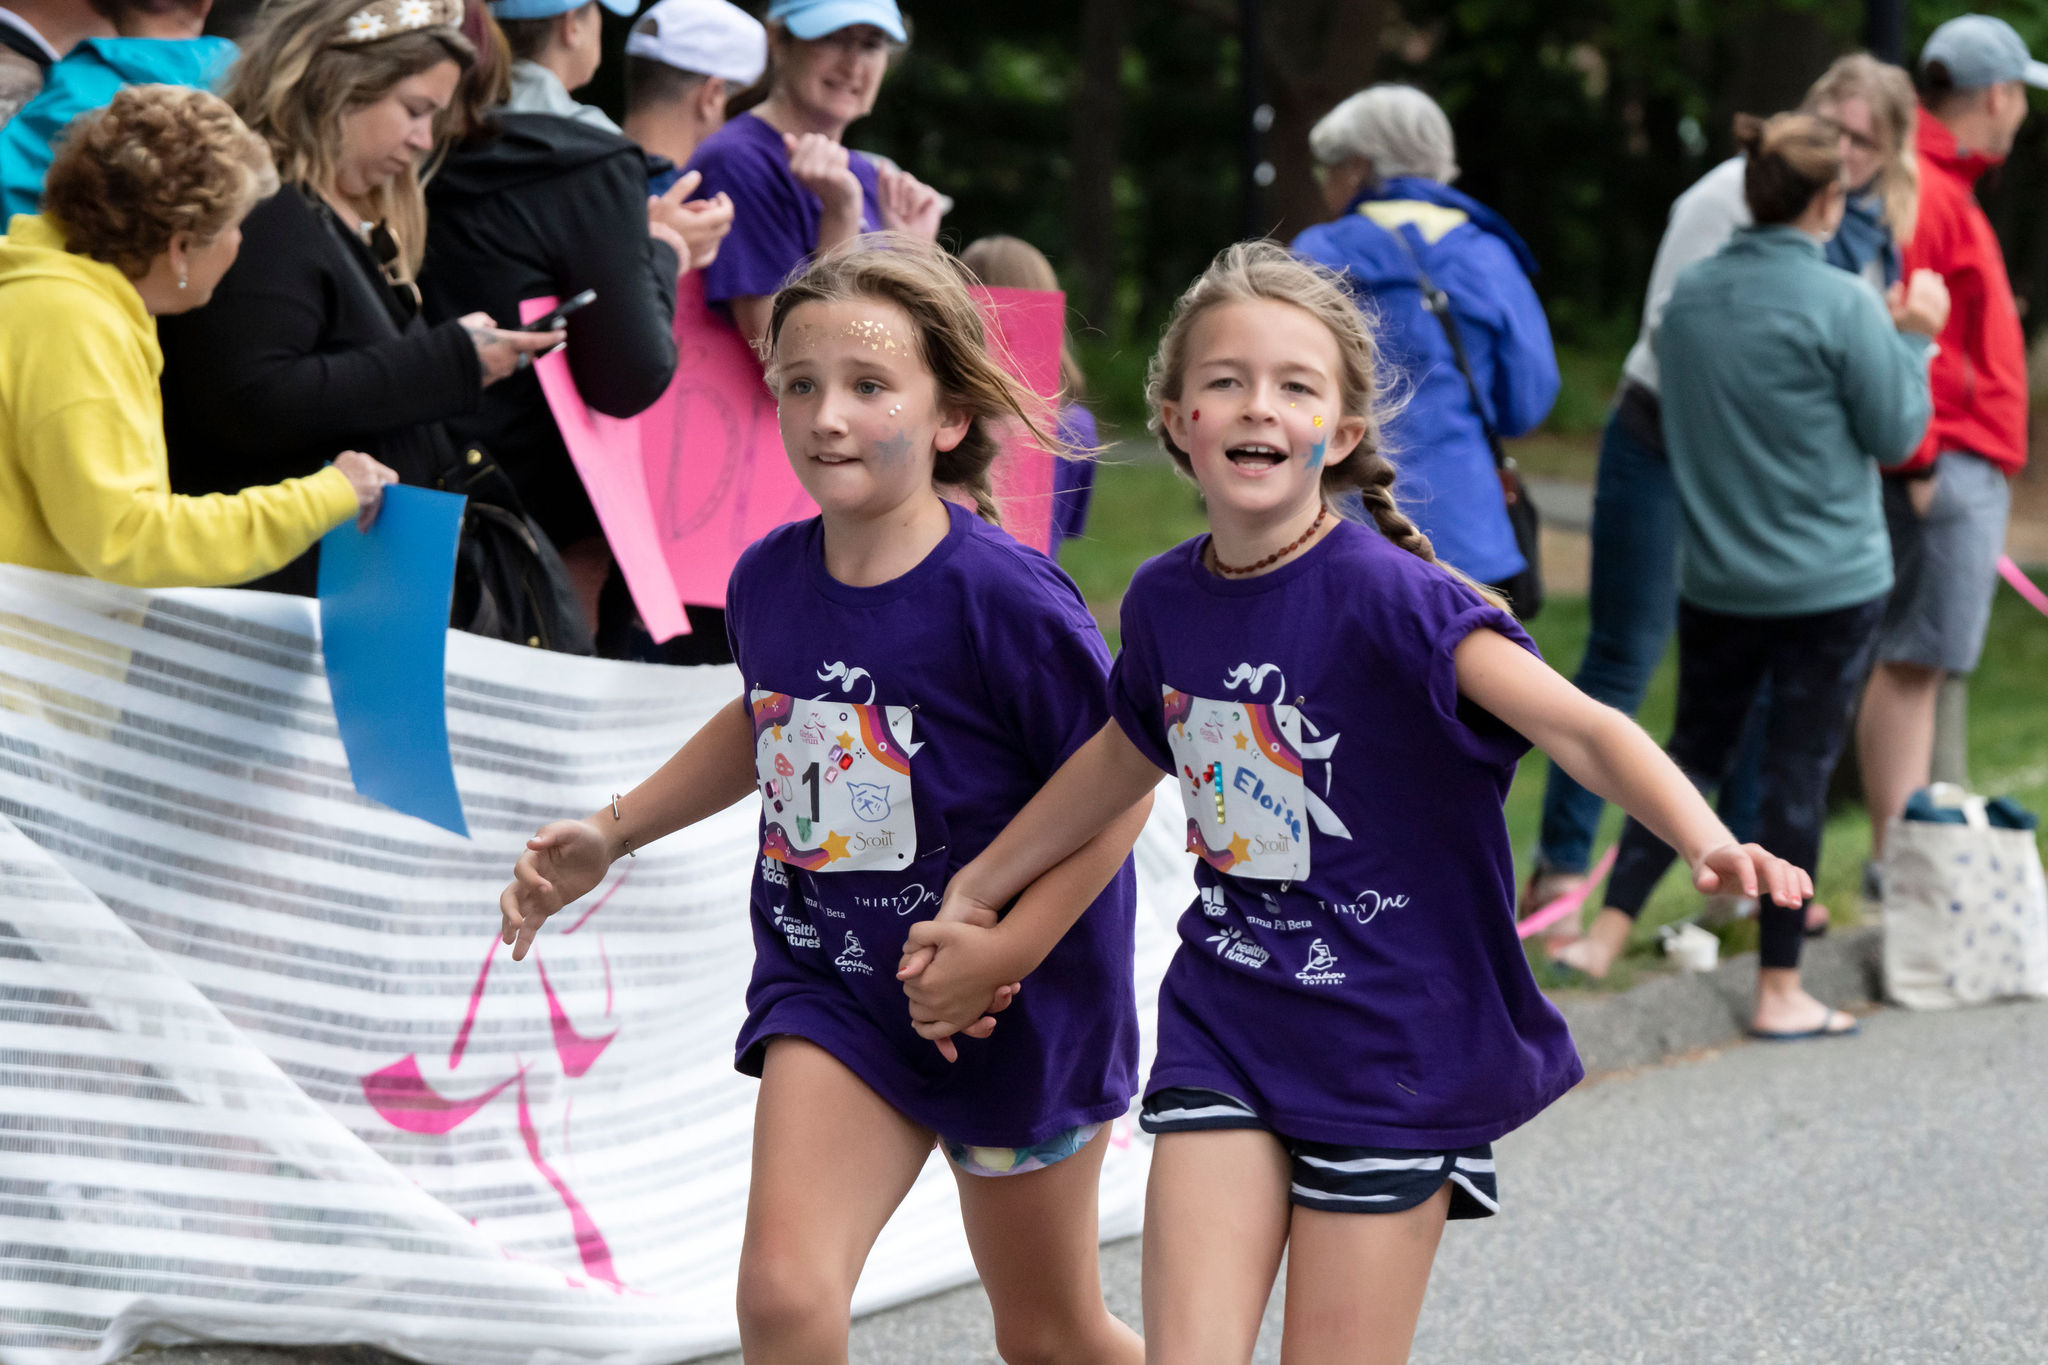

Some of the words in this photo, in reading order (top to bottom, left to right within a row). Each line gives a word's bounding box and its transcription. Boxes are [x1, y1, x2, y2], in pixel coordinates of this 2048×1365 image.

[802, 762, 820, 823] 1
[1233, 766, 1301, 843] Eloise
[854, 829, 895, 851] Scout
[1253, 832, 1292, 855] Scout
[826, 907, 846, 919] Beta
[854, 896, 910, 908] THIRTY
[1355, 890, 1410, 924] One
[1287, 919, 1312, 931] Beta
[1225, 949, 1262, 968] futures
[1232, 940, 1271, 965] healthy
